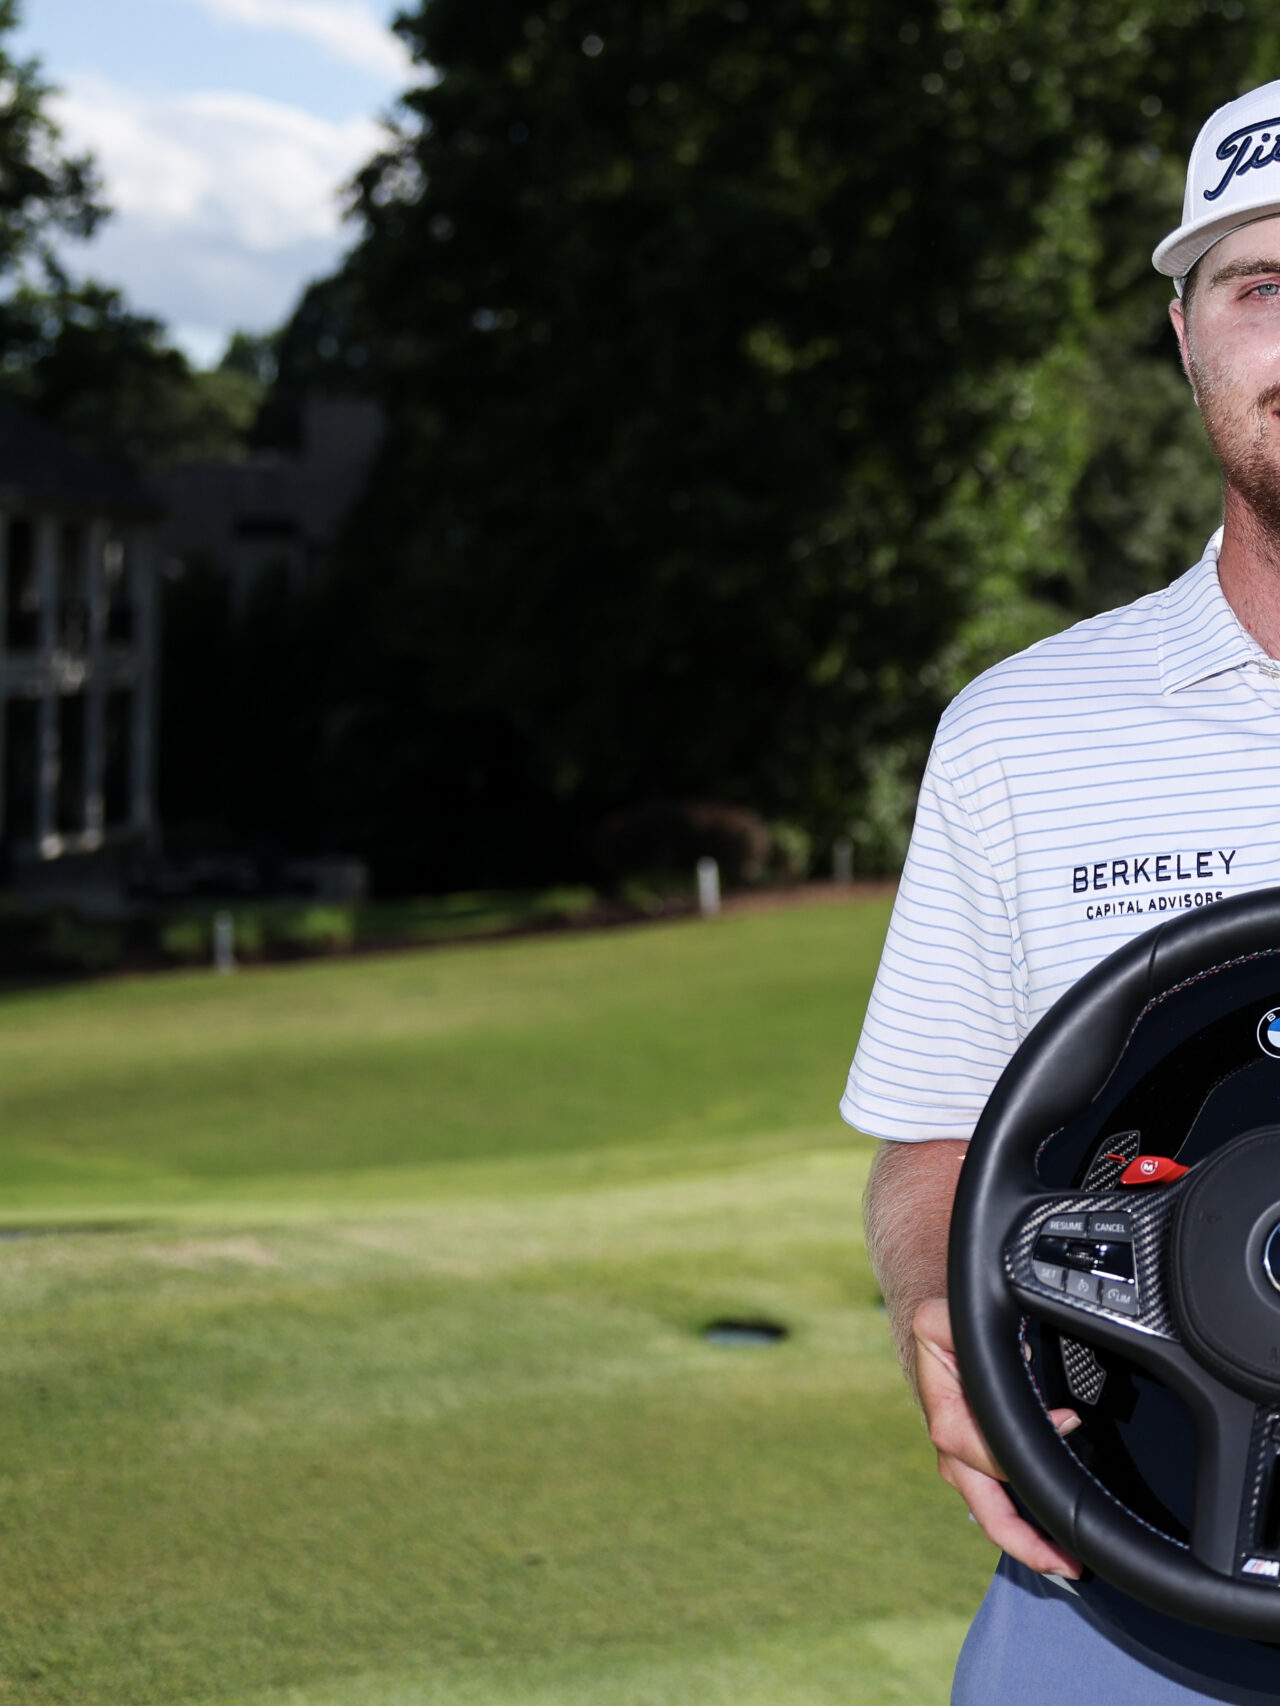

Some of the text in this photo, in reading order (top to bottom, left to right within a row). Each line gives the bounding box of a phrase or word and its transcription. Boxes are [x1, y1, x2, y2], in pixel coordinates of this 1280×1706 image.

[1073, 850, 1236, 893] BERKELEY
[1086, 900, 1143, 920] CAPITAL
[1050, 1220, 1083, 1231] RESUME
[1095, 1222, 1125, 1233] CANCEL
